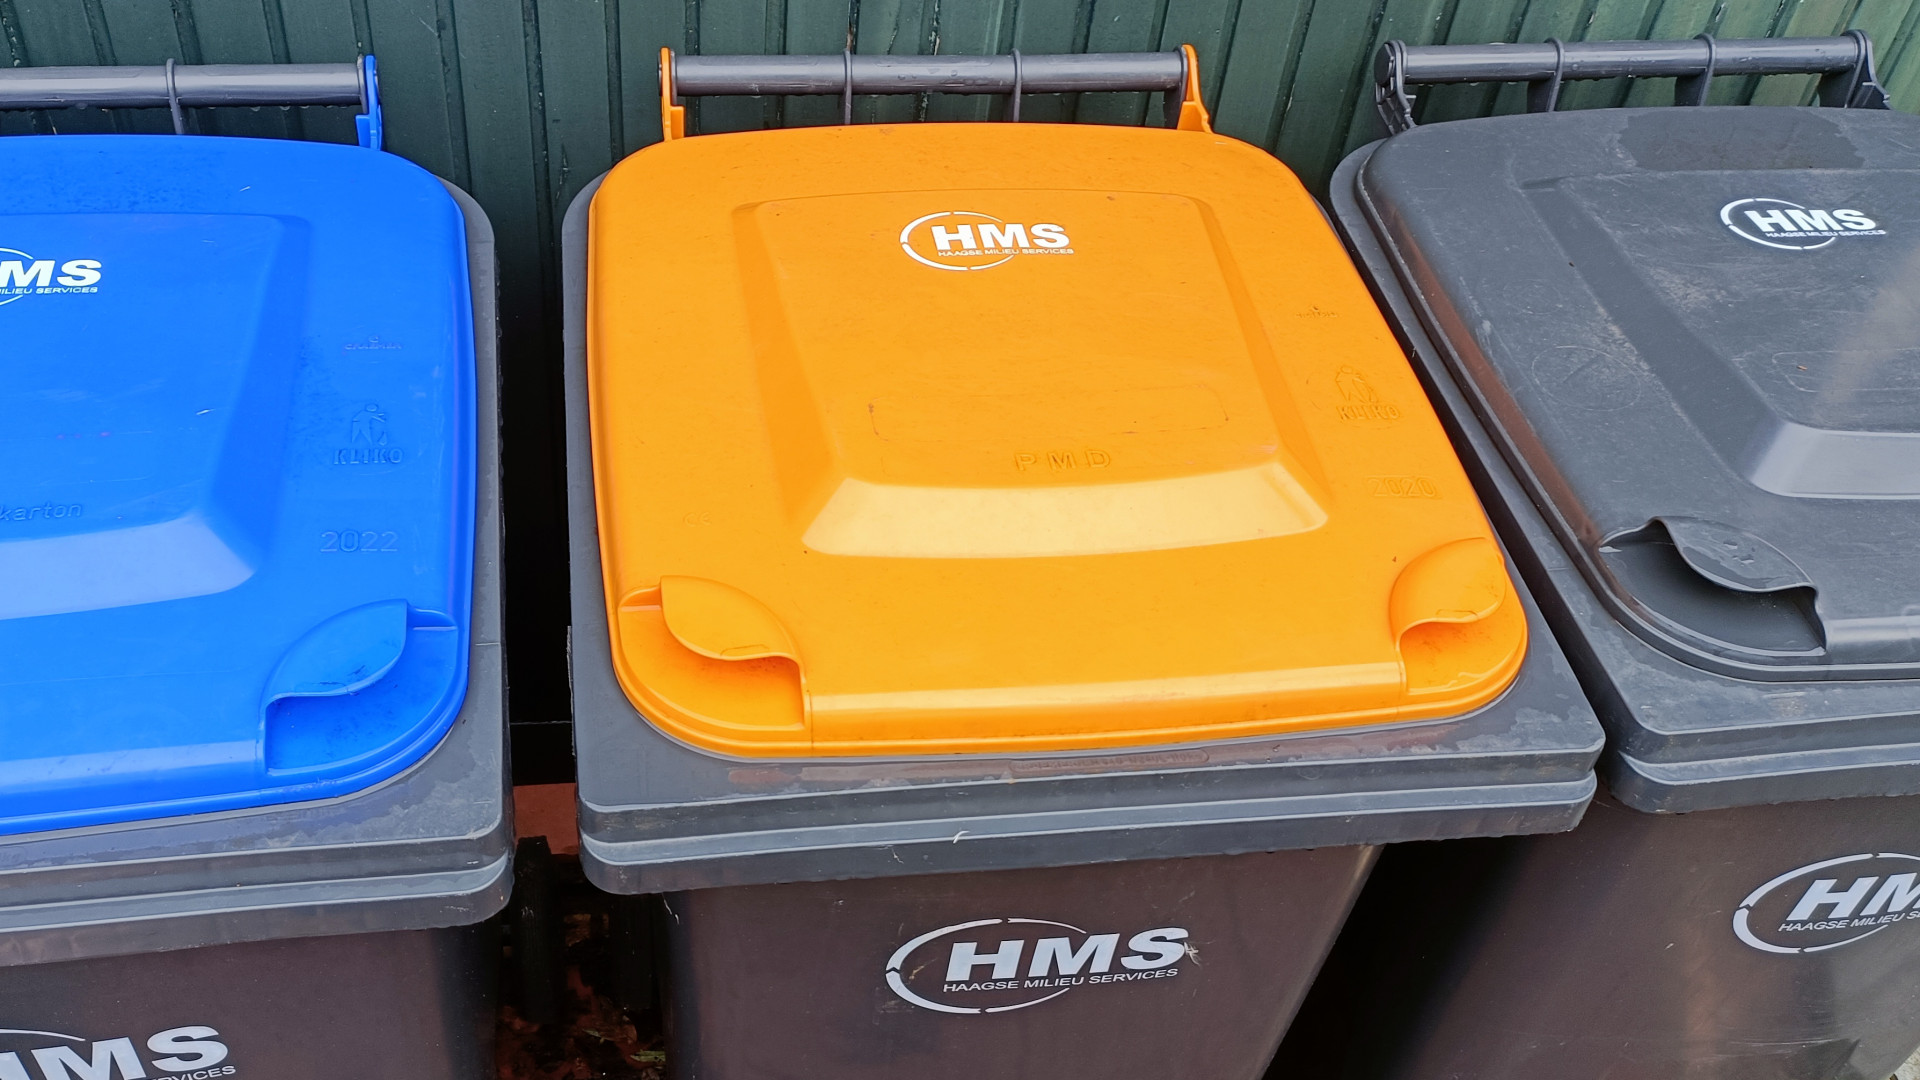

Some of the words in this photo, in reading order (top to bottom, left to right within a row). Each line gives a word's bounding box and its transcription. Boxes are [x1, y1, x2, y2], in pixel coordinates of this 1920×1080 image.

[1743, 209, 1878, 233] HMS
[931, 223, 1071, 251] HMS
[1806, 230, 1838, 238] MILIEU
[1838, 228, 1888, 237] SERVICES
[938, 249, 983, 257] HAAGSE
[1022, 247, 1075, 255] SERVICES
[0, 287, 33, 295] ILIEU
[35, 286, 98, 295] SERVICES
[1335, 404, 1402, 421] KLIKO
[333, 447, 404, 465] KLIKO
[1366, 476, 1440, 498] 2020
[319, 530, 400, 553] 2022
[1778, 917, 1850, 932] HAAGSE
[1850, 912, 1906, 927] MILIEU
[944, 927, 1189, 982] HMS
[943, 980, 1019, 993] HAAGSE
[1024, 976, 1085, 988] MILIEU
[1088, 967, 1179, 985] SERVICES
